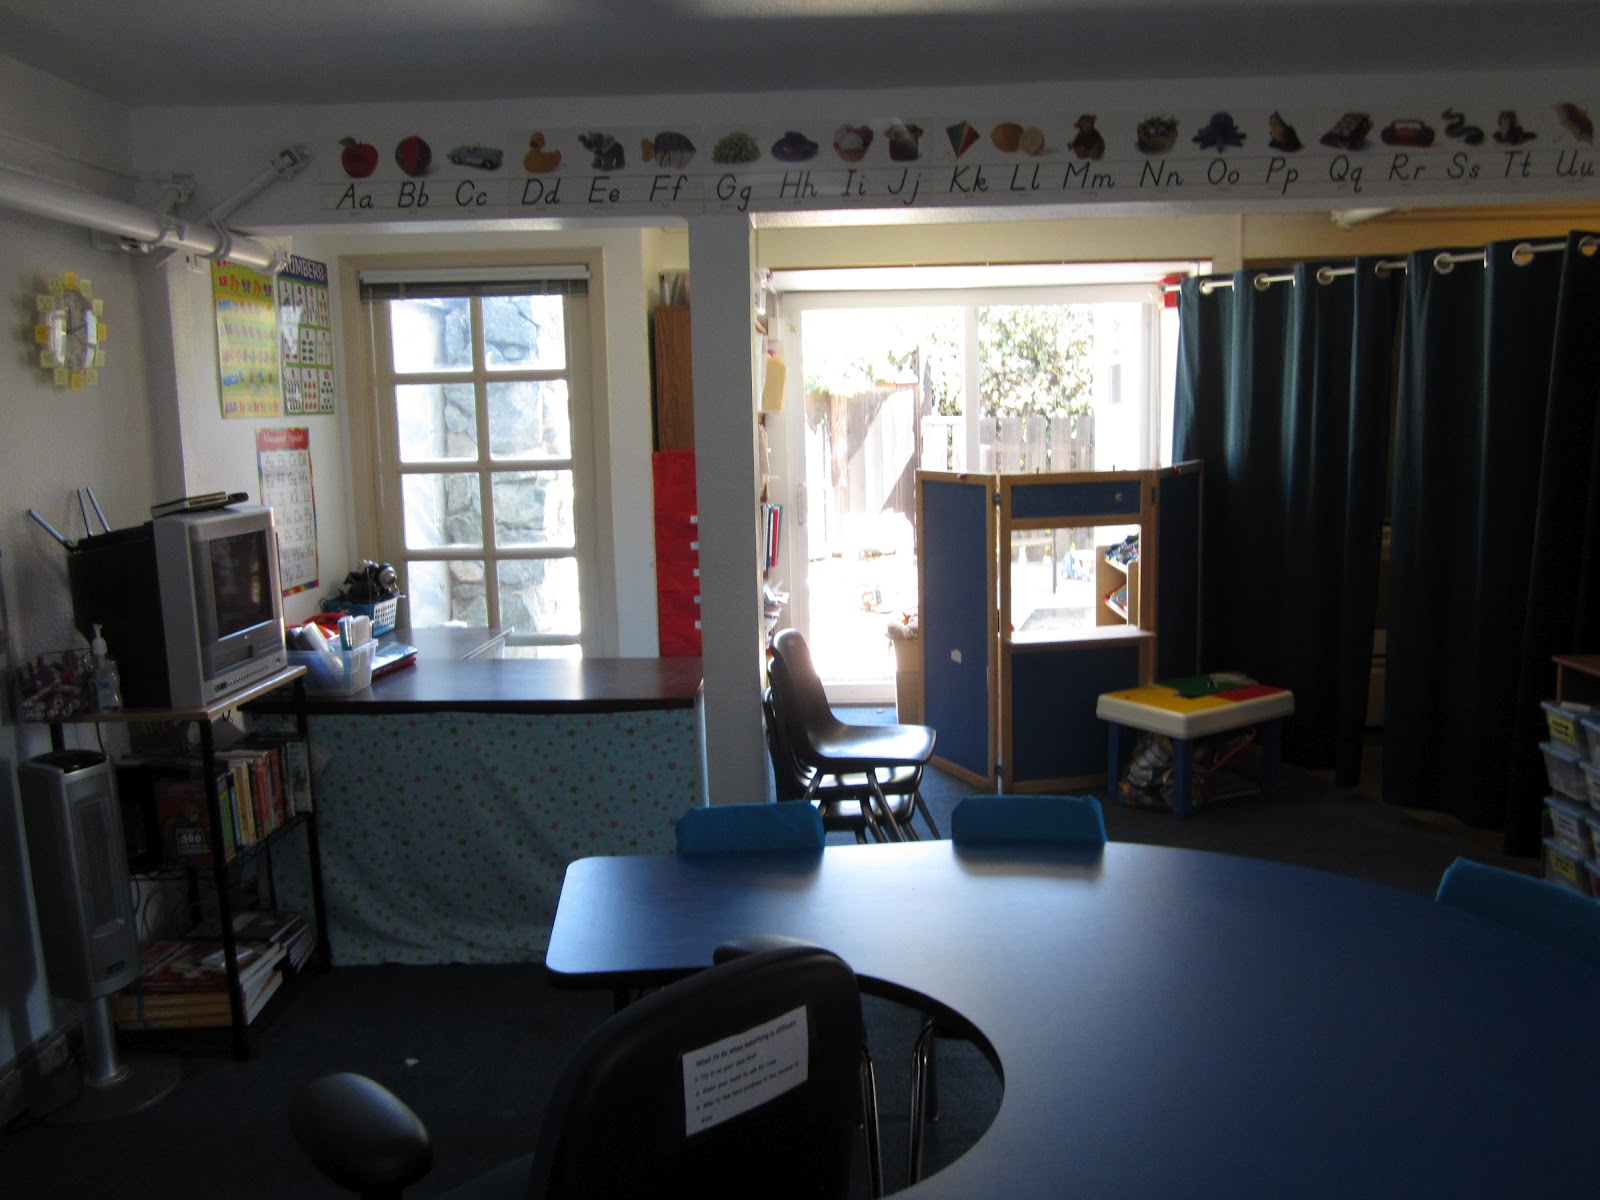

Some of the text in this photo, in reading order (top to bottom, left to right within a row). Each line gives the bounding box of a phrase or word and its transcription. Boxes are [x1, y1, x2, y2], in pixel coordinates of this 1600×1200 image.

[336, 148, 1595, 211] Aa Bb Cc Dd Ee Ff Gg Hh Ii Jj Kk Ll Mm Nn Oo Pp Qq Rr Ss Tt Uu
[284, 256, 324, 281] NUMBERS
